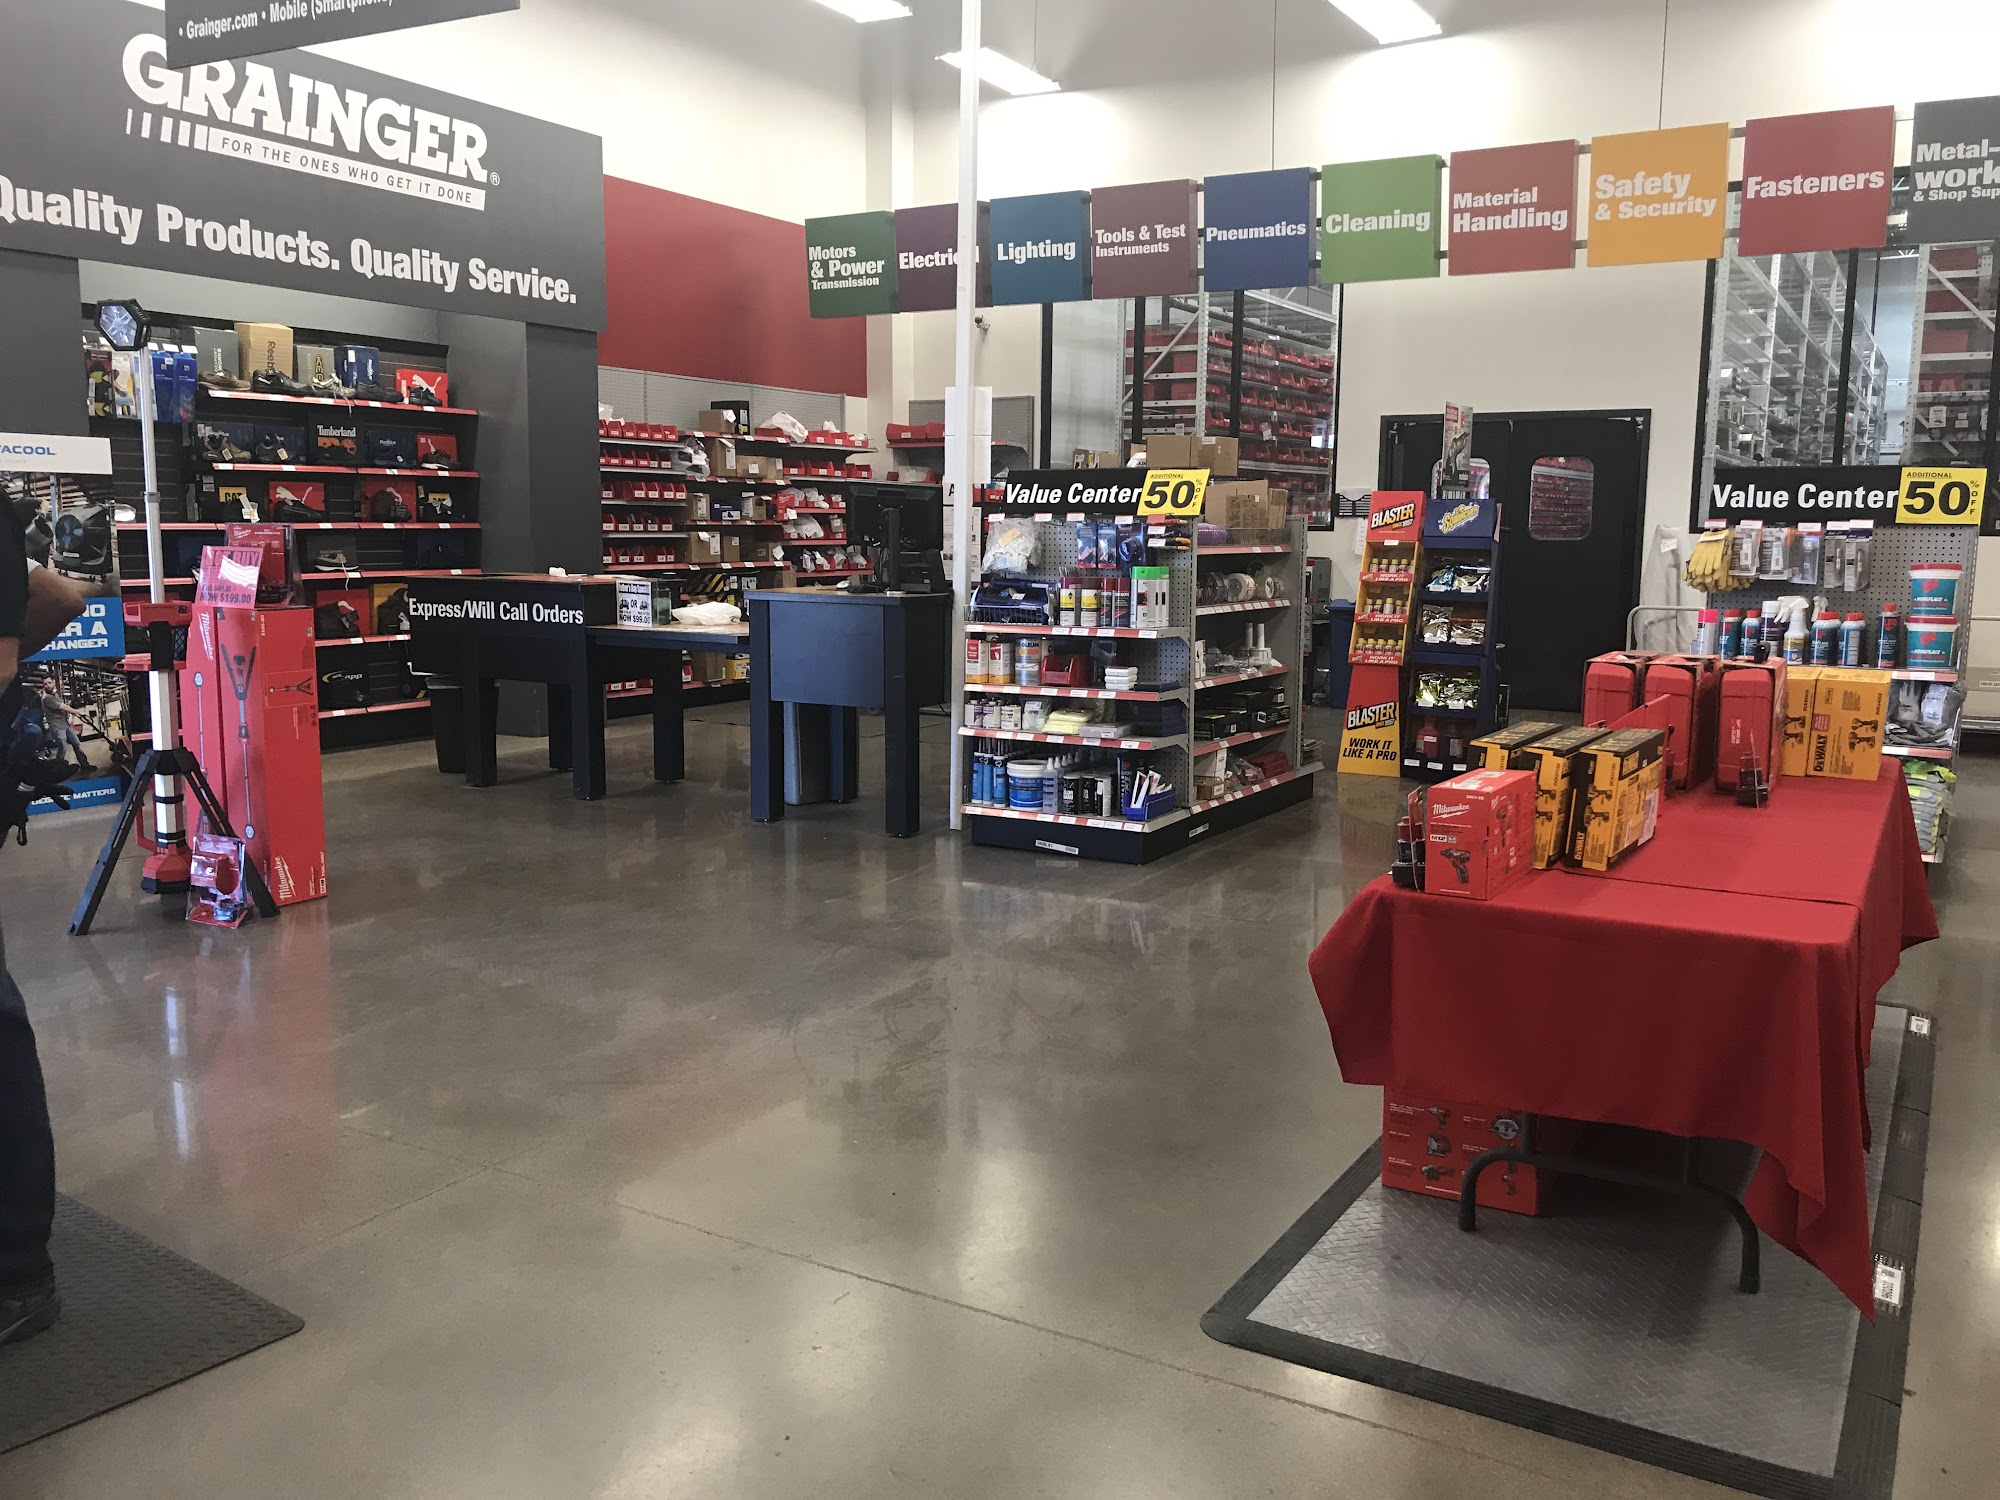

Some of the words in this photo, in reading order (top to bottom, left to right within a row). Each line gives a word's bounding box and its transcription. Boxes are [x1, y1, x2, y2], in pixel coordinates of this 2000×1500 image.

[186, 12, 258, 39] Grainger.com
[269, 0, 308, 23] Mobile
[122, 33, 488, 183] GRAINGER
[1916, 138, 2000, 163] Metal-
[222, 137, 252, 155] FOR
[262, 146, 291, 163] THE
[300, 155, 339, 174] ONES
[348, 165, 379, 183] WHO
[387, 175, 412, 190] GET
[419, 182, 431, 194] IT
[438, 186, 472, 203] DONE
[1595, 170, 1692, 201] Safety
[1746, 169, 1886, 199] Fasteners
[1913, 190, 1924, 202] &
[1928, 189, 1967, 202] Shop
[1453, 186, 1538, 210] Material
[1595, 203, 1612, 221] &
[1618, 195, 1718, 220] Security
[1206, 221, 1307, 242] Pneumatics
[1325, 209, 1431, 234] Cleaning
[1452, 207, 1569, 234] Handling
[1095, 226, 1135, 245] Tools
[1139, 225, 1151, 241] &
[1154, 223, 1186, 240] Test
[157, 203, 340, 271] Products.
[350, 238, 460, 293] Quality
[468, 258, 578, 304] Service.
[808, 245, 857, 261] Motors
[997, 239, 1076, 265] Lighting
[1095, 240, 1170, 258] Instruments
[811, 263, 824, 279] &
[828, 259, 885, 278] Power
[811, 276, 880, 290] Transmission
[315, 356, 324, 382] KEE
[317, 425, 356, 437] Timberland
[0, 445, 57, 455] ACOOL
[1006, 483, 1062, 504] Value
[1067, 482, 1143, 503] Center
[1144, 480, 1196, 509] 50
[1713, 484, 1789, 509] Value
[1798, 483, 1899, 509] Center
[1903, 481, 1970, 516] 50
[1371, 503, 1415, 529] BLASTER
[409, 598, 495, 620] Express/Will
[500, 602, 528, 621] Call
[532, 603, 584, 625] Orders
[91, 621, 107, 635] A
[41, 638, 108, 651] HANGER
[1348, 701, 1395, 729] BLASTER
[1343, 748, 1364, 758] LIKE
[1366, 749, 1374, 759] A
[1376, 750, 1397, 761] PRO
[1350, 738, 1381, 749] WORK
[1382, 740, 1393, 750] IT
[73, 788, 116, 799] MATTERS
[1432, 802, 1470, 815] Milwaukee
[274, 856, 293, 901] Milwaukee
